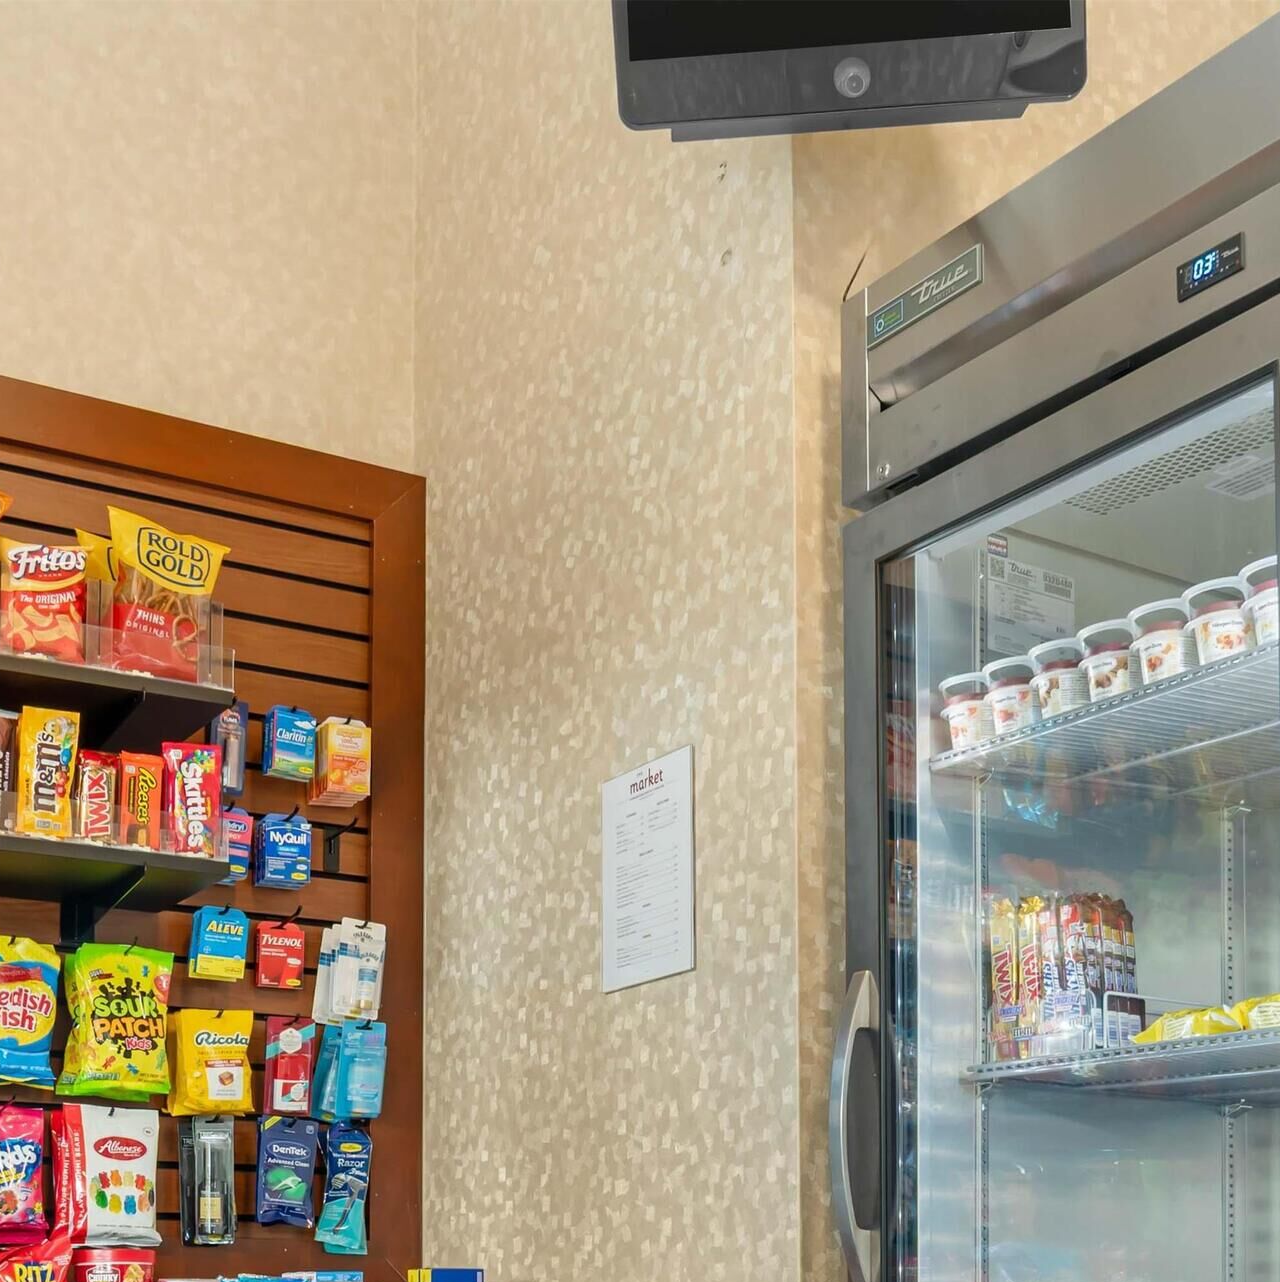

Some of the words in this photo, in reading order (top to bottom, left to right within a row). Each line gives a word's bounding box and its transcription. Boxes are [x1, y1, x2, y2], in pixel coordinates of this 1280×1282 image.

[147, 531, 205, 562] ROLD
[8, 545, 87, 579] Fritos
[145, 550, 204, 581] GOLD
[35, 590, 77, 604] ORIGINAL
[135, 609, 165, 625] THINS
[276, 726, 307, 744] Claritin
[629, 767, 664, 795] market
[85, 772, 111, 838] TWIX
[180, 762, 208, 849] Skittles
[270, 831, 307, 847] NyQuil
[207, 920, 245, 936] ALEVE
[261, 934, 302, 948] TYLENOL
[93, 997, 158, 1018] SOUR
[93, 1018, 165, 1040] PATCH
[125, 1037, 152, 1050] Kids
[195, 1031, 249, 1046] Ricola
[272, 1143, 308, 1157] DenTek
[337, 1158, 366, 1168] Razor
